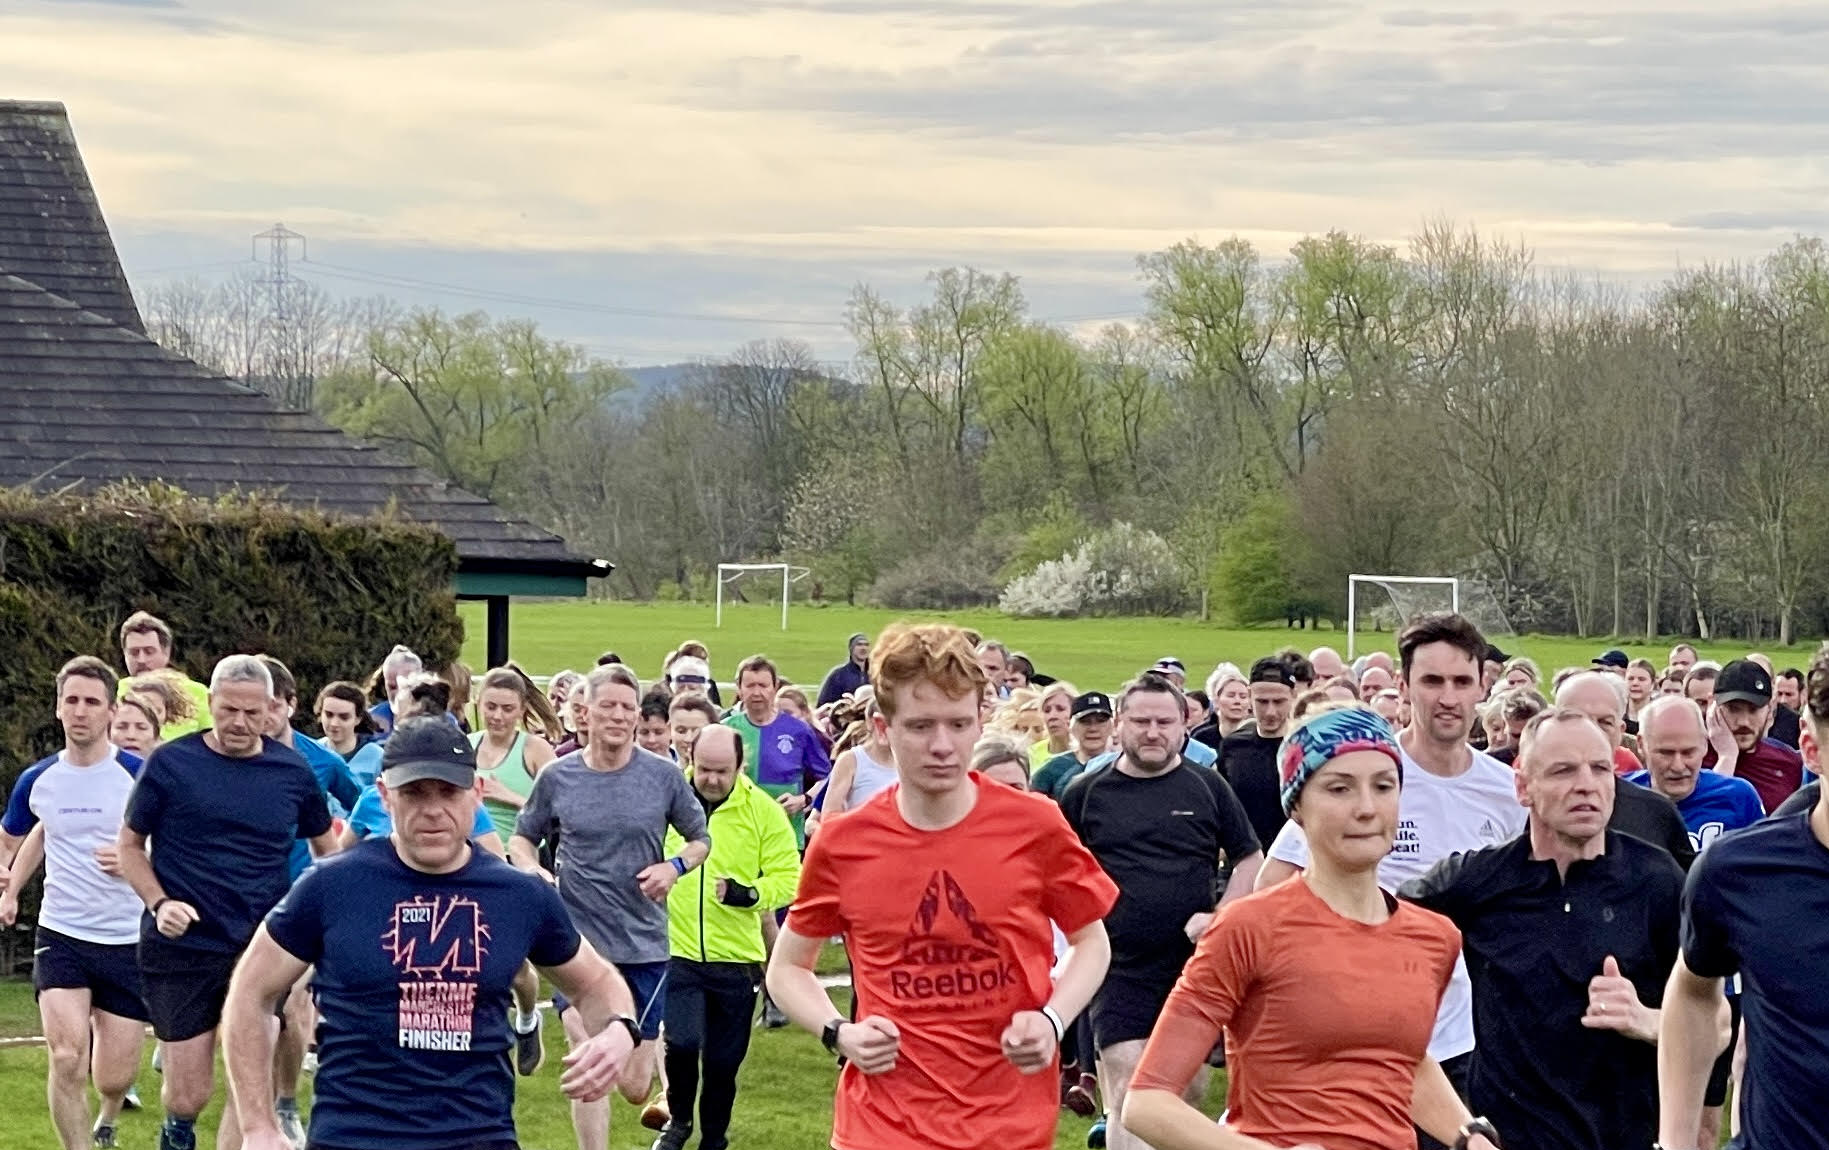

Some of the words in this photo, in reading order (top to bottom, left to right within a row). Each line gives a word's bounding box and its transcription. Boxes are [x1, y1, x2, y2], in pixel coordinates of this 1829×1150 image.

[402, 907, 431, 923] 2021
[890, 961, 1016, 999] Reebok
[399, 1012, 472, 1031] MARATHON
[398, 1028, 472, 1051] FINISHER
